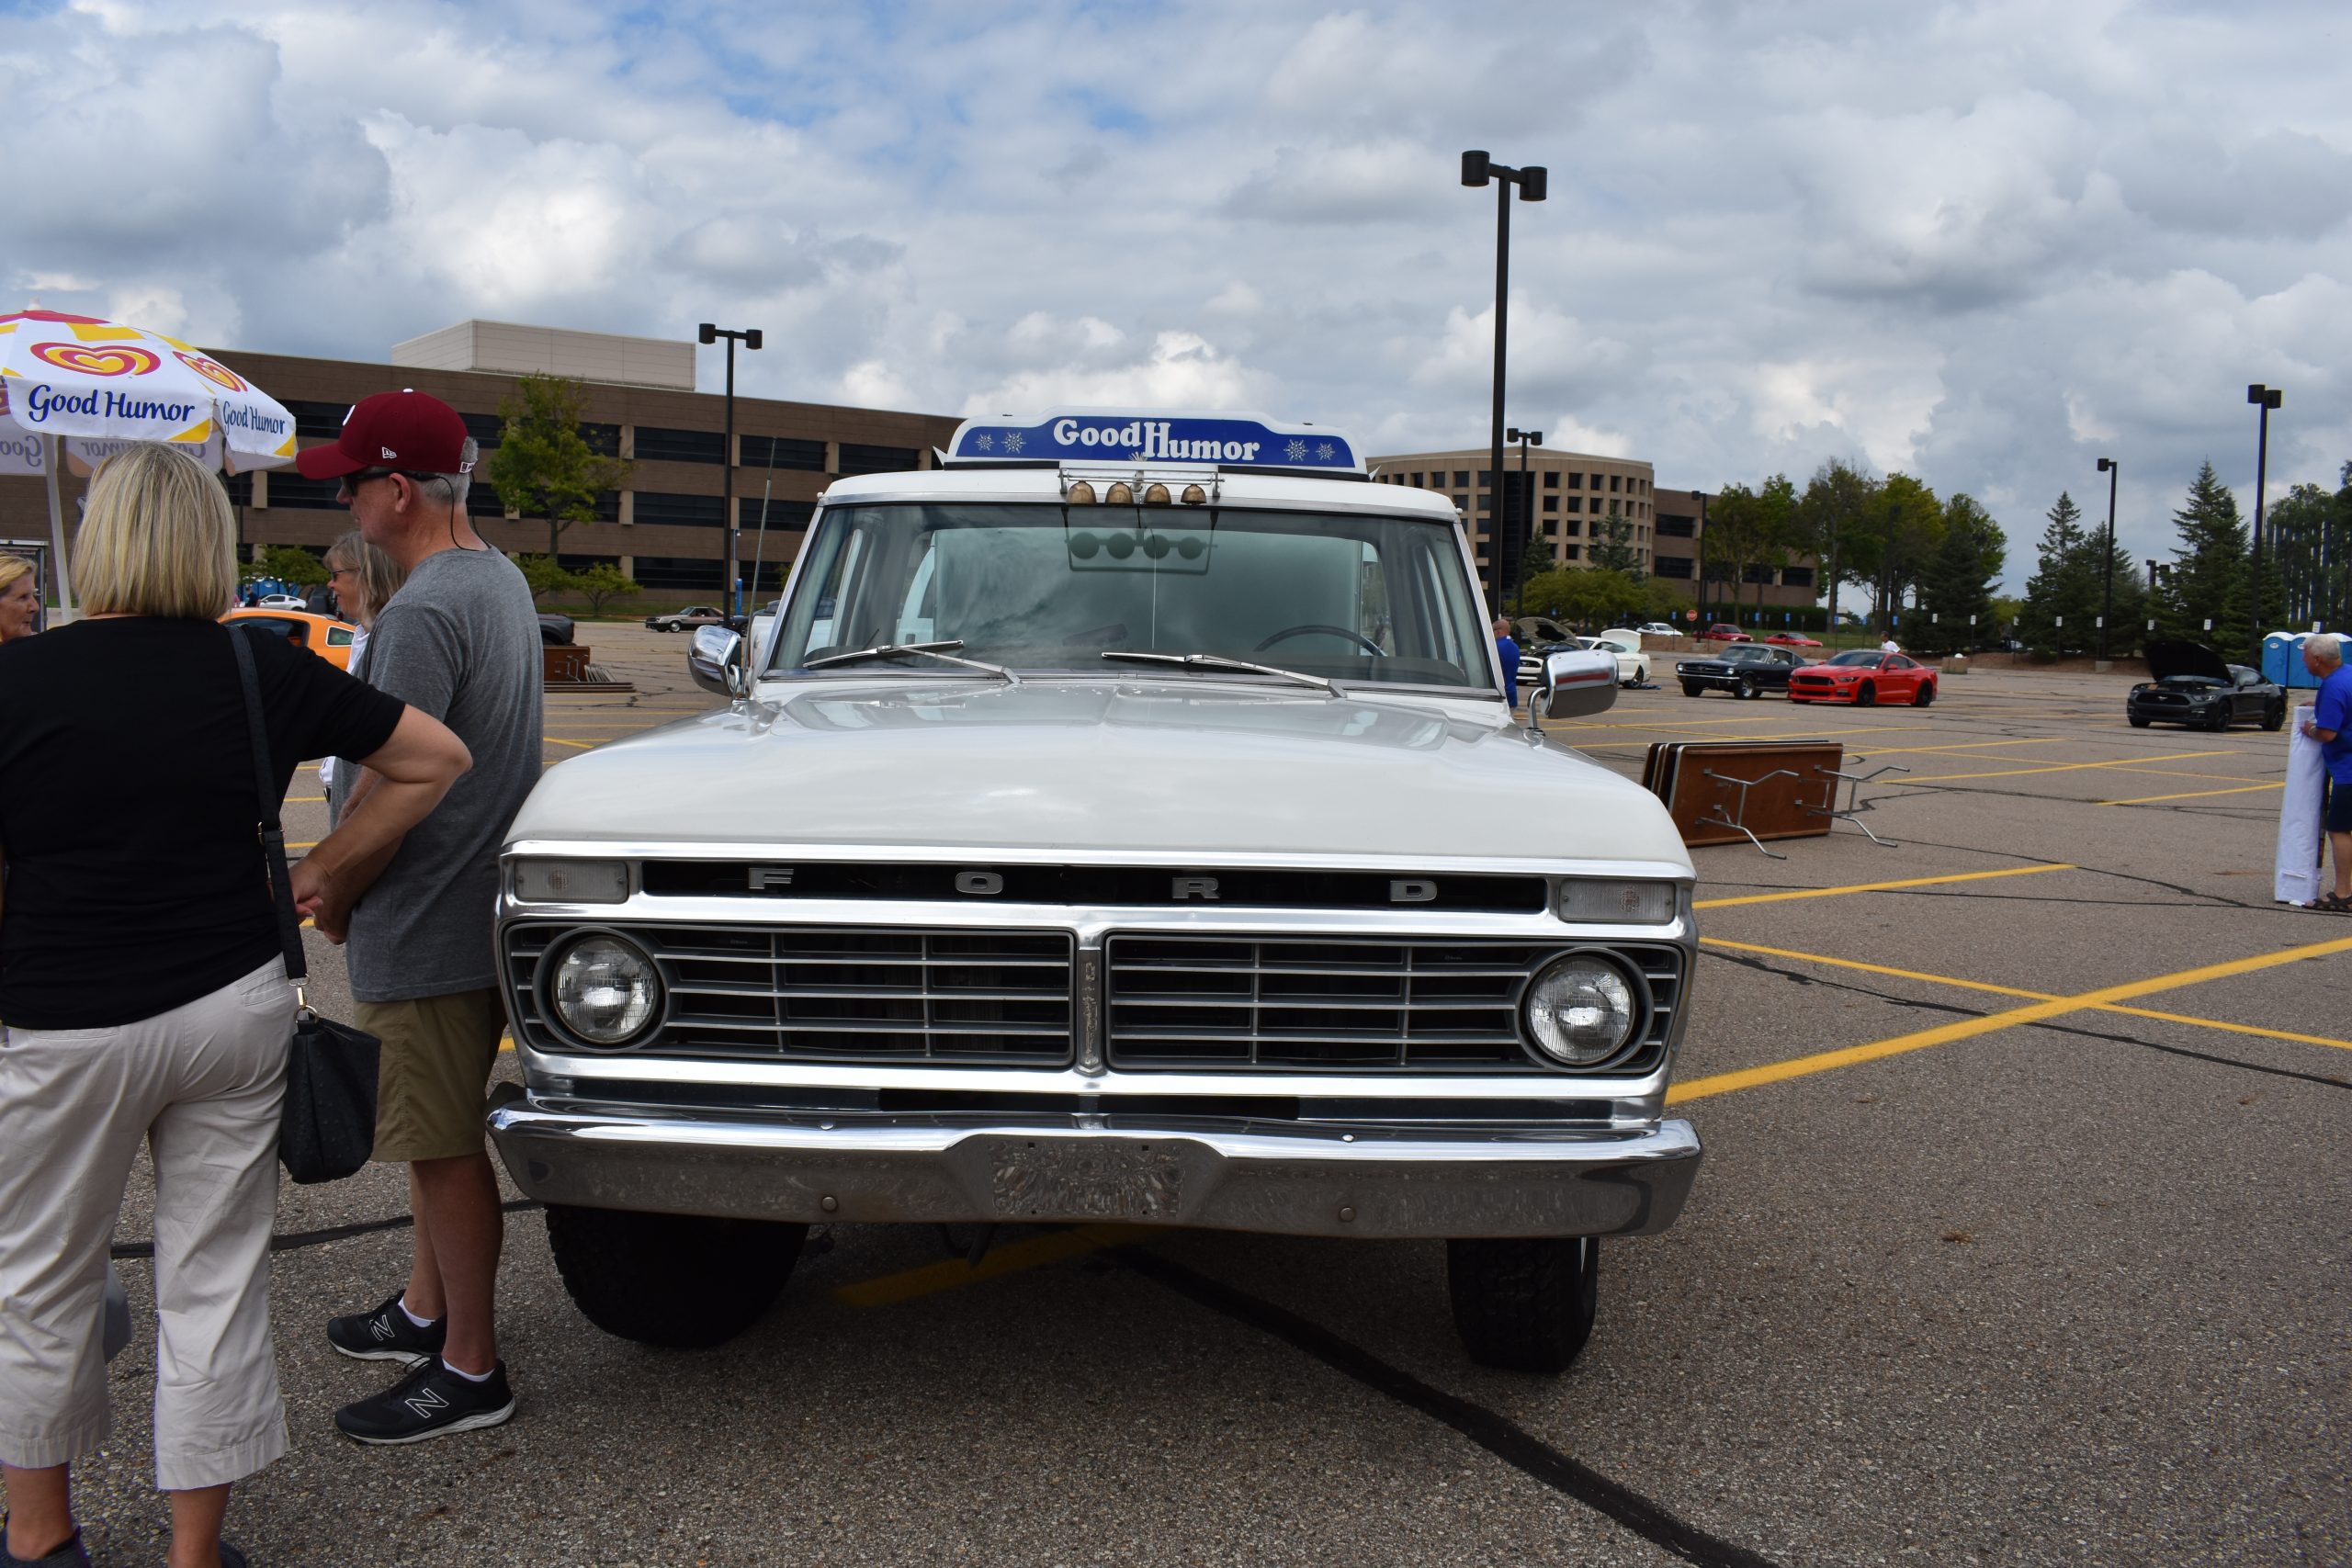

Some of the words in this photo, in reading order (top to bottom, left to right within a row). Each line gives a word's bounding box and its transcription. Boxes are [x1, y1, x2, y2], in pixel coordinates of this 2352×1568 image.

[28, 384, 99, 423] Good
[105, 390, 195, 422] Humor
[222, 400, 248, 435] Good
[249, 406, 285, 434] Humor
[1053, 419, 1142, 447] Good
[1143, 422, 1261, 460] Humor
[748, 868, 1439, 903] FORD
